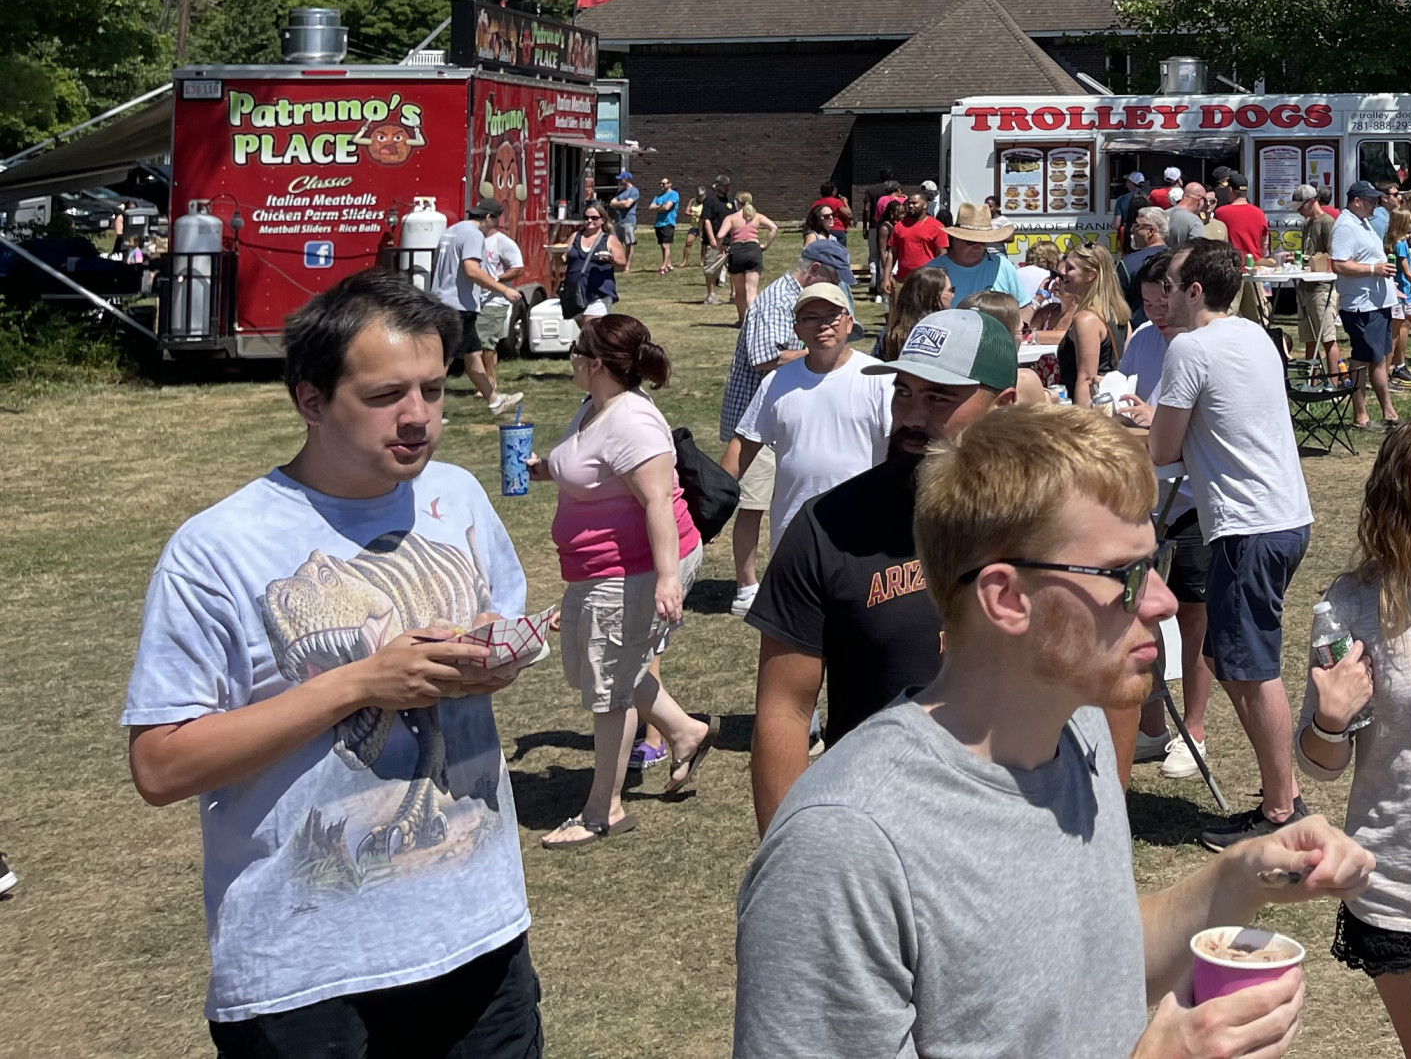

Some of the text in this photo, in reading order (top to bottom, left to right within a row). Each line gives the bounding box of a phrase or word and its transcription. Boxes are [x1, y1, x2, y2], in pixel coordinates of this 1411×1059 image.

[534, 48, 558, 69] PLACE
[229, 91, 422, 128] Patruno's
[485, 100, 529, 138] Patruno's
[964, 103, 1333, 132] TROLLEY DOGS
[234, 134, 359, 165] PLACE
[288, 175, 354, 193] Classic
[266, 193, 377, 207] Italian Meatballs
[252, 209, 385, 222] Chicken Parm Sliders
[259, 223, 381, 234] Meatball Sliders Rice Balls
[866, 559, 927, 609] ARIZ
